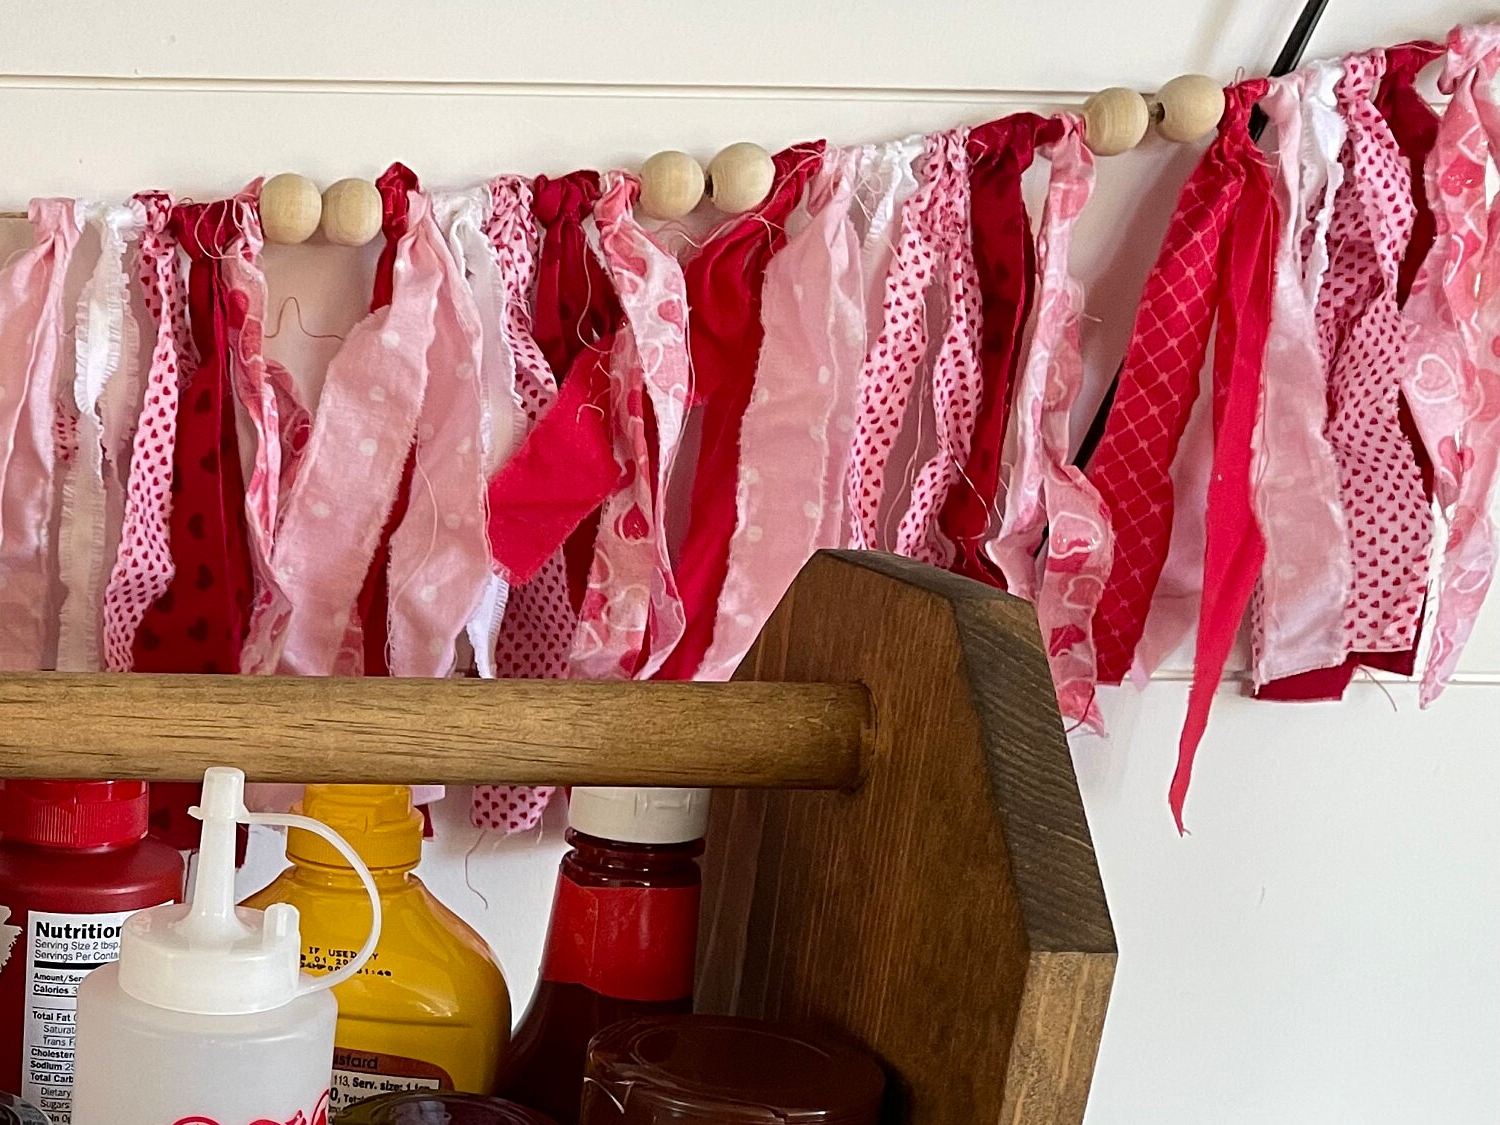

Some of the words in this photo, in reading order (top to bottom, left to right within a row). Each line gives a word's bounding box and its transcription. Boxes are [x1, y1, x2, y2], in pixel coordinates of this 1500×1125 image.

[34, 938, 69, 952] Serving
[71, 941, 91, 951] Size
[93, 941, 99, 951] 2
[34, 949, 73, 963] Servings
[75, 952, 91, 962] Per
[93, 951, 119, 961] Conta
[309, 946, 320, 954] IF
[328, 949, 357, 959] USED
[335, 958, 349, 966] 20
[33, 972, 84, 984] Amount/Ser
[33, 984, 69, 994] Calories
[32, 1010, 54, 1021] Total
[56, 1013, 71, 1022] Fat
[43, 1024, 75, 1035] Saturat
[43, 1036, 66, 1047] Trans
[30, 1060, 63, 1071] Sodium
[30, 1072, 51, 1082] Total
[53, 1074, 74, 1084] Carb
[352, 1076, 377, 1090] Serv.
[40, 1087, 71, 1099] Dietary
[40, 1099, 70, 1110] Sugars
